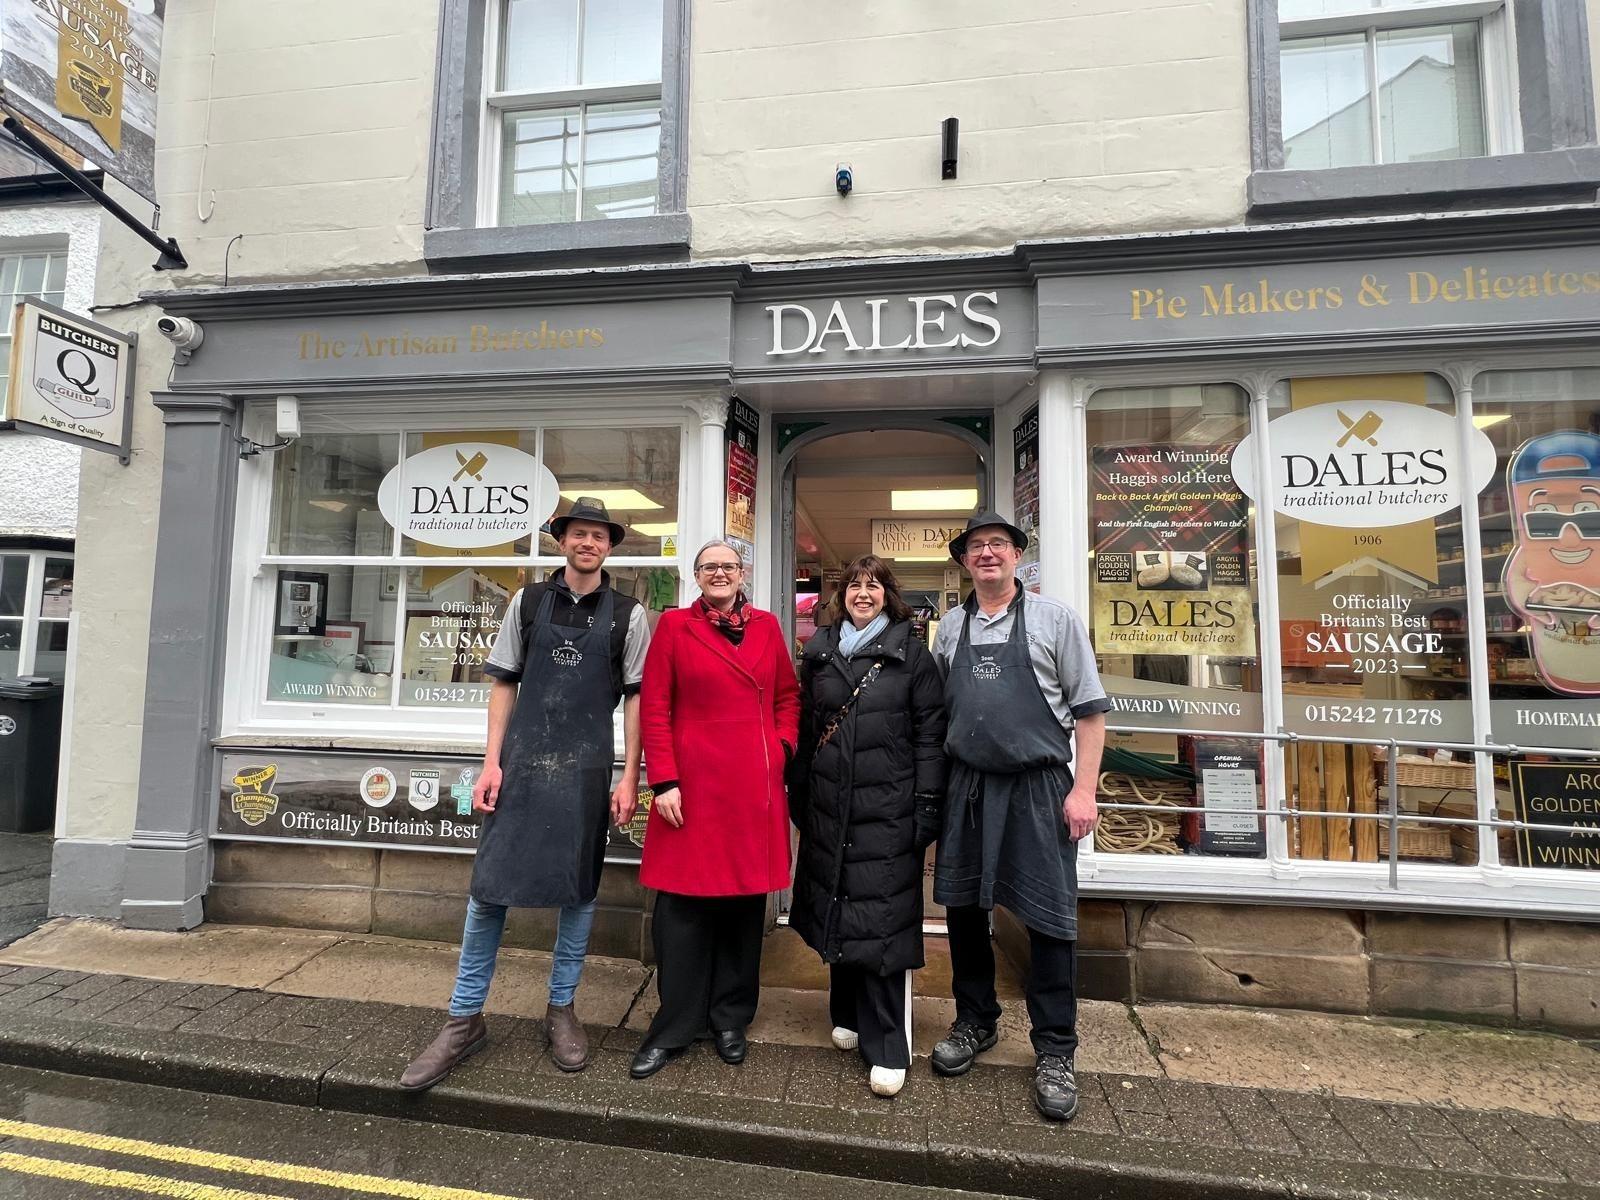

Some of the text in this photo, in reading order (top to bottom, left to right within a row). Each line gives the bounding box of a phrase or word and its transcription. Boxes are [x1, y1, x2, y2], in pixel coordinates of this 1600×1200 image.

[69, 34, 115, 76] 2023
[1130, 288, 1187, 321] Pie
[1200, 279, 1344, 317] Makers
[1358, 274, 1392, 307] &
[765, 291, 1001, 355] DALES
[40, 318, 117, 356] BUTCHERS
[297, 320, 606, 361] The Artisan Butchers
[56, 349, 99, 396] Q
[57, 387, 93, 403] GUILD
[735, 401, 758, 429] DALES
[50, 416, 66, 428] Sign
[68, 422, 77, 430] of
[78, 424, 104, 438] Quality
[1114, 450, 1229, 465] Award Winning
[1281, 449, 1447, 488] DALES
[1109, 472, 1231, 487] Haggis sold Here
[410, 484, 529, 515] DALES
[1096, 493, 1117, 501] Back
[1130, 493, 1151, 501] Back
[1153, 492, 1178, 502] Argyll
[1180, 492, 1211, 501] Golden
[1213, 492, 1243, 502] Haggis
[1283, 489, 1448, 507] traditional butchers
[1144, 504, 1193, 513] Champions
[409, 517, 528, 531] traditional butchers
[883, 523, 906, 533] FINE
[1143, 520, 1170, 529] English
[1170, 520, 1203, 528] Butchers
[877, 532, 916, 542] DINING
[923, 527, 965, 542] DAL
[1160, 530, 1177, 538] Title
[1353, 535, 1382, 546] 1906
[456, 549, 473, 557] 1906
[881, 541, 911, 551] WITH
[441, 601, 498, 617] Officially
[1333, 594, 1412, 613] Officially
[1109, 600, 1236, 628] DALES
[1320, 613, 1427, 628] Britain's Best
[431, 616, 502, 629] Britain's Bes
[1110, 630, 1236, 643] traditional butchers
[1306, 632, 1443, 654] SAUSAGE
[450, 653, 483, 666] 2023
[551, 649, 583, 660] DALES
[972, 665, 1002, 674] DALES
[1353, 658, 1399, 674] 2023
[283, 682, 377, 698] AWARD WINNING
[415, 688, 492, 703] 015242 712
[1109, 697, 1240, 716] AWARD WINNING
[1305, 705, 1443, 726] 015242 71278
[242, 770, 269, 784] WINNER
[235, 795, 275, 805] Champion
[281, 811, 362, 836] Officially
[367, 815, 434, 837] Britain's
[439, 819, 480, 839] Best
[1538, 846, 1600, 864] WINN
